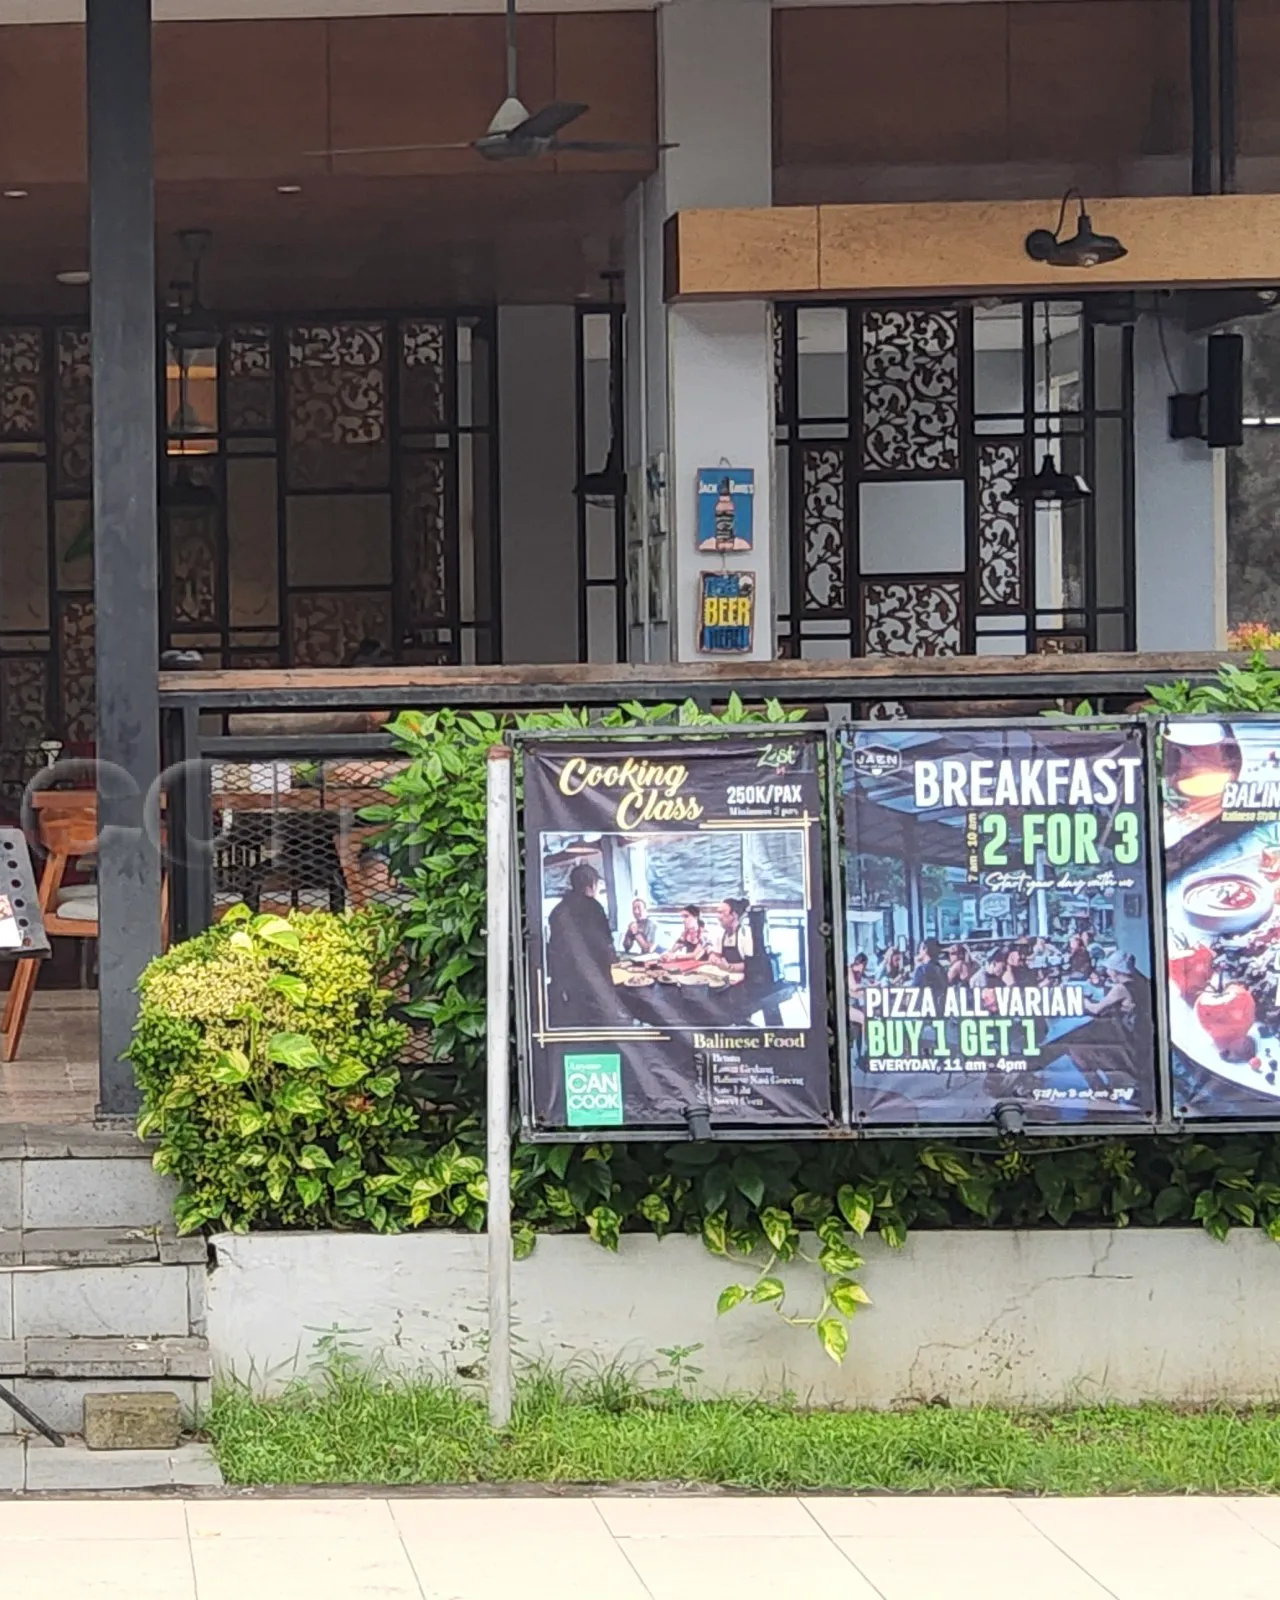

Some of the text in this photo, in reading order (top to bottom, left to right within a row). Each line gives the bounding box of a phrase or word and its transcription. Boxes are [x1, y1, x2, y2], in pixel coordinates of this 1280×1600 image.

[704, 597, 750, 626] BEER
[856, 754, 897, 765] JAEN
[559, 757, 689, 797] Cooking
[914, 757, 1141, 807] BREAKFAST
[727, 784, 802, 805] 250K/PAX
[616, 789, 703, 830] Class
[983, 811, 1138, 865] 2 FOR 3
[866, 986, 1083, 1017] PIZZA ALL VARIAN
[693, 1032, 805, 1048] Balinese Food
[868, 1019, 1040, 1057] BUY 1 GET 1
[869, 1059, 941, 1073] EVERYDAY,
[944, 1059, 962, 1071] 11
[965, 1061, 986, 1071] am
[997, 1058, 1026, 1074] 4pm
[568, 1072, 618, 1093] CAN
[568, 1093, 621, 1109] COOK
